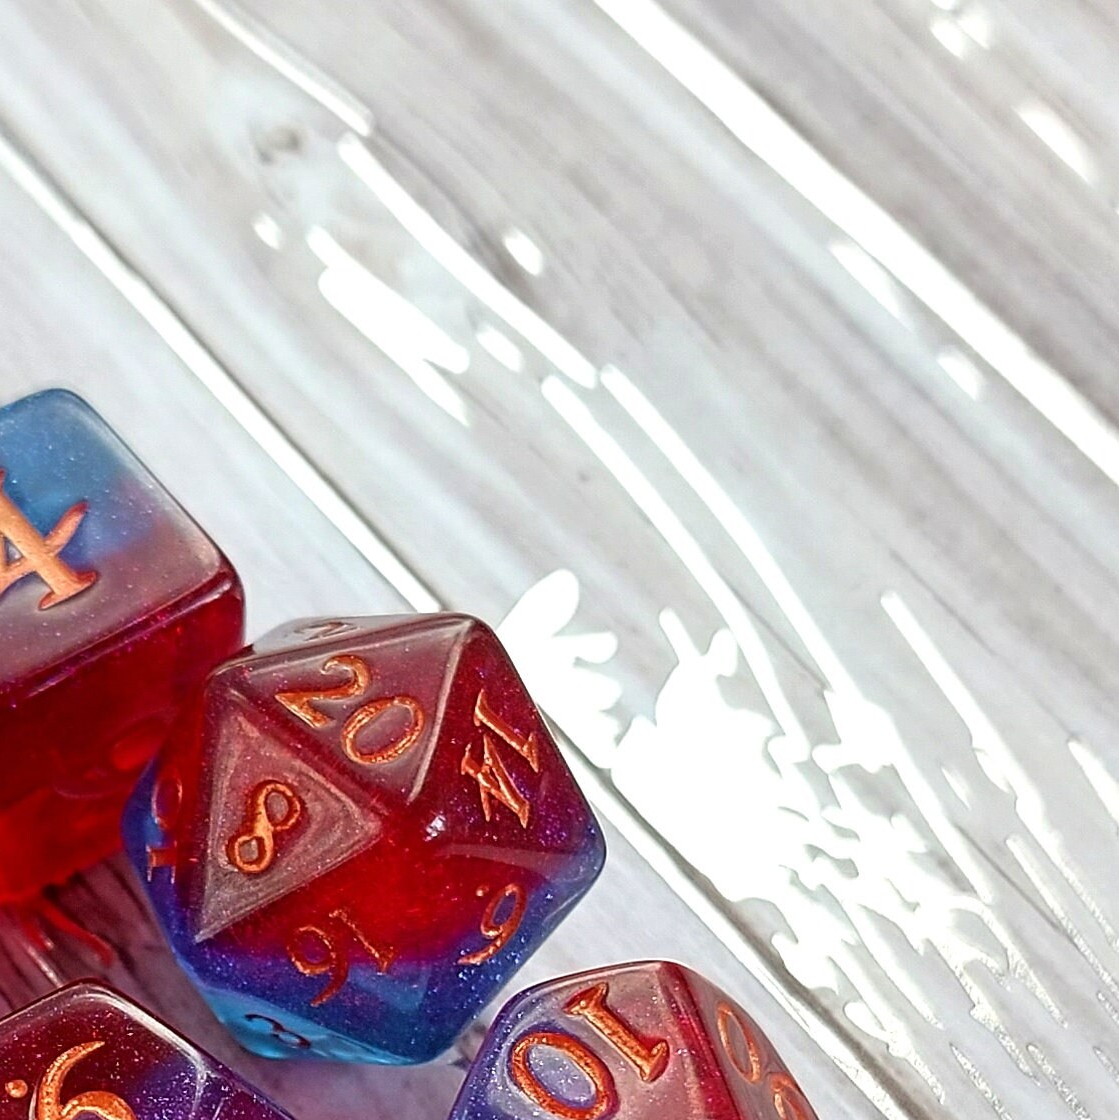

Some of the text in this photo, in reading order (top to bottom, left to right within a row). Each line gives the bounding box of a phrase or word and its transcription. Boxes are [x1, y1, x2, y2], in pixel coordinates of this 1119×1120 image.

[274, 654, 425, 766] 20
[460, 689, 539, 829] 14
[226, 780, 306, 875] 8
